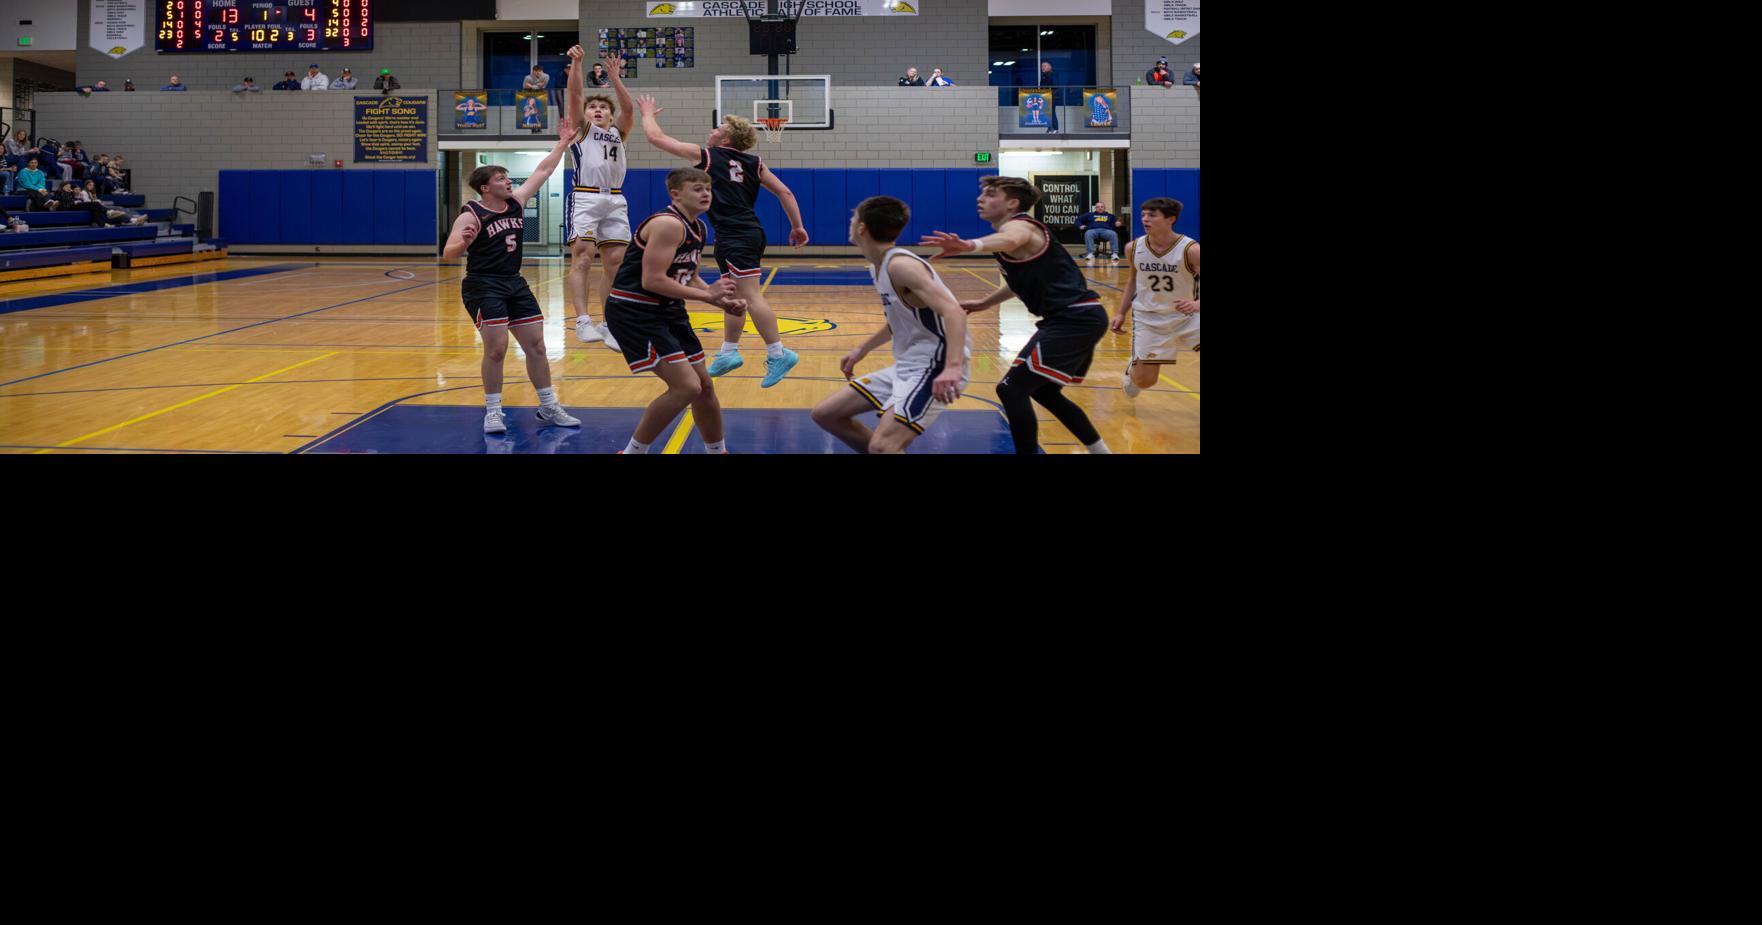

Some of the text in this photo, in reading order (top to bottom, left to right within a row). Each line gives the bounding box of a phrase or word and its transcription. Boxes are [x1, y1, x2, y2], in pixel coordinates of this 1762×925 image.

[166, 1, 201, 10] 2 0 0
[702, 1, 766, 9] CASCADE
[806, 1, 862, 9] SCHOOL
[166, 10, 173, 19] 5
[195, 10, 201, 19] 0
[222, 8, 238, 23] 13
[264, 10, 268, 21] 1
[304, 8, 315, 21] 4
[332, 9, 367, 17] 5 0 0
[804, 8, 817, 16] OF
[824, 8, 862, 16] FAME
[177, 20, 183, 29] 0
[195, 20, 201, 28] 4
[343, 18, 349, 27] 0
[361, 18, 368, 27] 2
[159, 30, 201, 39] 23 0 5
[214, 30, 223, 41] 2
[251, 29, 279, 41] 10 2
[287, 31, 294, 41] 3
[307, 29, 315, 41] 3
[325, 28, 367, 37] 32 0 0
[176, 40, 183, 48] 2
[343, 38, 350, 46] 3
[593, 132, 621, 144] CASCA
[603, 144, 618, 162] 14
[977, 153, 990, 162] EXIT
[728, 159, 744, 183] 2
[1042, 183, 1081, 193] CONTROL
[1049, 194, 1074, 204] WHAT
[1044, 205, 1080, 214] YOU CAN
[1042, 215, 1078, 225] CONTRO
[505, 234, 517, 252] 5
[1139, 262, 1178, 273] CASCADE
[1148, 275, 1174, 292] 23
